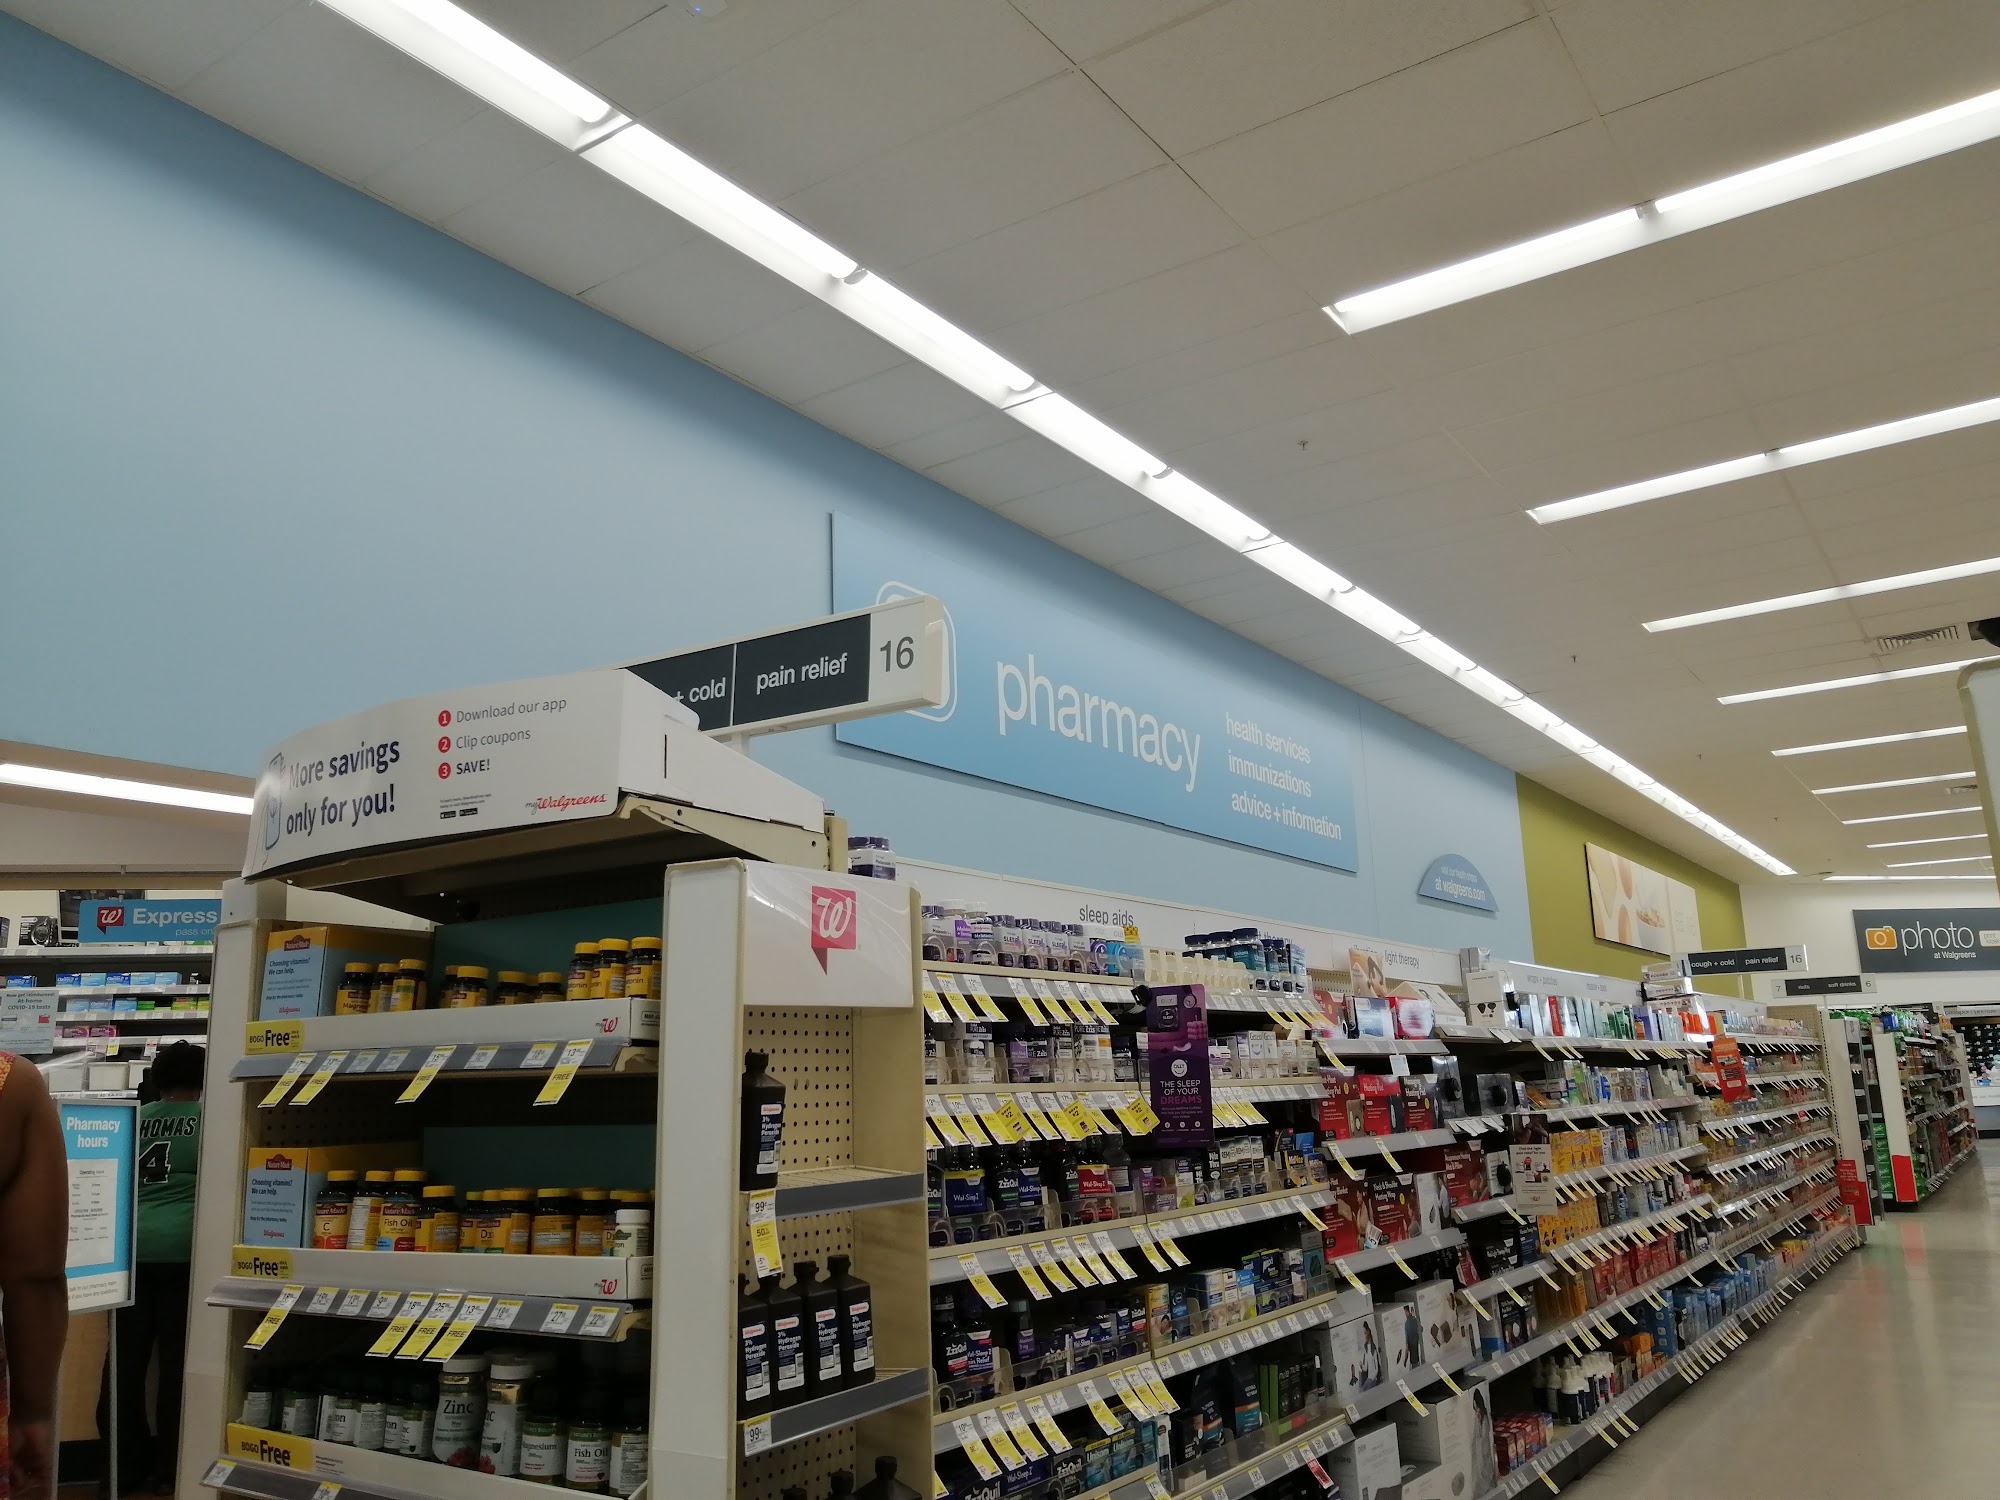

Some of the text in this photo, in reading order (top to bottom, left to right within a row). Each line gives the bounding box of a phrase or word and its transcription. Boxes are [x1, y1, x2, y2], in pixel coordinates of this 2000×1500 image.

[880, 636, 915, 673] 16
[756, 652, 848, 695] pain relief
[689, 677, 727, 703] cold
[456, 702, 515, 724] Download
[518, 701, 540, 715] our
[542, 698, 567, 714] app
[997, 653, 1201, 792] pharmacy
[456, 734, 478, 751] Clip
[481, 727, 531, 748] coupons
[1225, 712, 1311, 765] health services
[289, 738, 400, 791] More savings
[456, 759, 491, 776] SAVE!
[1228, 749, 1312, 799] immunizations
[286, 783, 396, 837] only for you!
[1231, 790, 1342, 841] advice + information
[1435, 877, 1486, 902] at walgreens.com
[132, 908, 218, 928] Express
[1079, 904, 1134, 926] sleep aids
[175, 928, 198, 938] pass
[1901, 921, 1974, 956] photo
[1385, 949, 1420, 969] light therapy
[1745, 956, 1779, 966] pain relief
[1789, 954, 1803, 964] 16
[1942, 951, 1977, 960] Walgreens
[1691, 960, 1713, 968] cough
[1720, 958, 1735, 966] cold
[249, 1035, 265, 1044] BOGO
[265, 1029, 290, 1047] Free
[552, 1072, 570, 1081] FREE
[1164, 1087, 1199, 1096] OF YOUR
[1160, 1095, 1202, 1105] DREAMS
[67, 1117, 120, 1133] Pharmacy
[77, 1134, 109, 1148] hours
[139, 1141, 171, 1184] 4
[252, 1178, 292, 1187] Choosing vitamins?
[267, 1188, 277, 1196] help.
[323, 1222, 330, 1231] C
[384, 1219, 413, 1227] Fish Oil
[238, 1260, 252, 1270] BOGO
[253, 1257, 279, 1277] Free
[89, 1283, 107, 1292] pharmacy
[265, 1317, 280, 1325] FREE
[852, 1320, 871, 1330] Hydrogen
[389, 1325, 406, 1333] FREE
[418, 1327, 436, 1335] FREE
[447, 1329, 467, 1338] FREE
[818, 1327, 838, 1337] Hydrogen
[853, 1327, 870, 1335] Peroxide
[778, 1335, 801, 1346] Hydrogen
[819, 1334, 836, 1342] Peroxide
[745, 1343, 767, 1354] Hydrogen
[778, 1343, 800, 1351] Peroxide
[745, 1350, 766, 1360] Peroxide
[443, 1400, 474, 1415] Zinc
[241, 1439, 291, 1467] BOGO Free
[574, 1447, 608, 1458] Fish Oil
